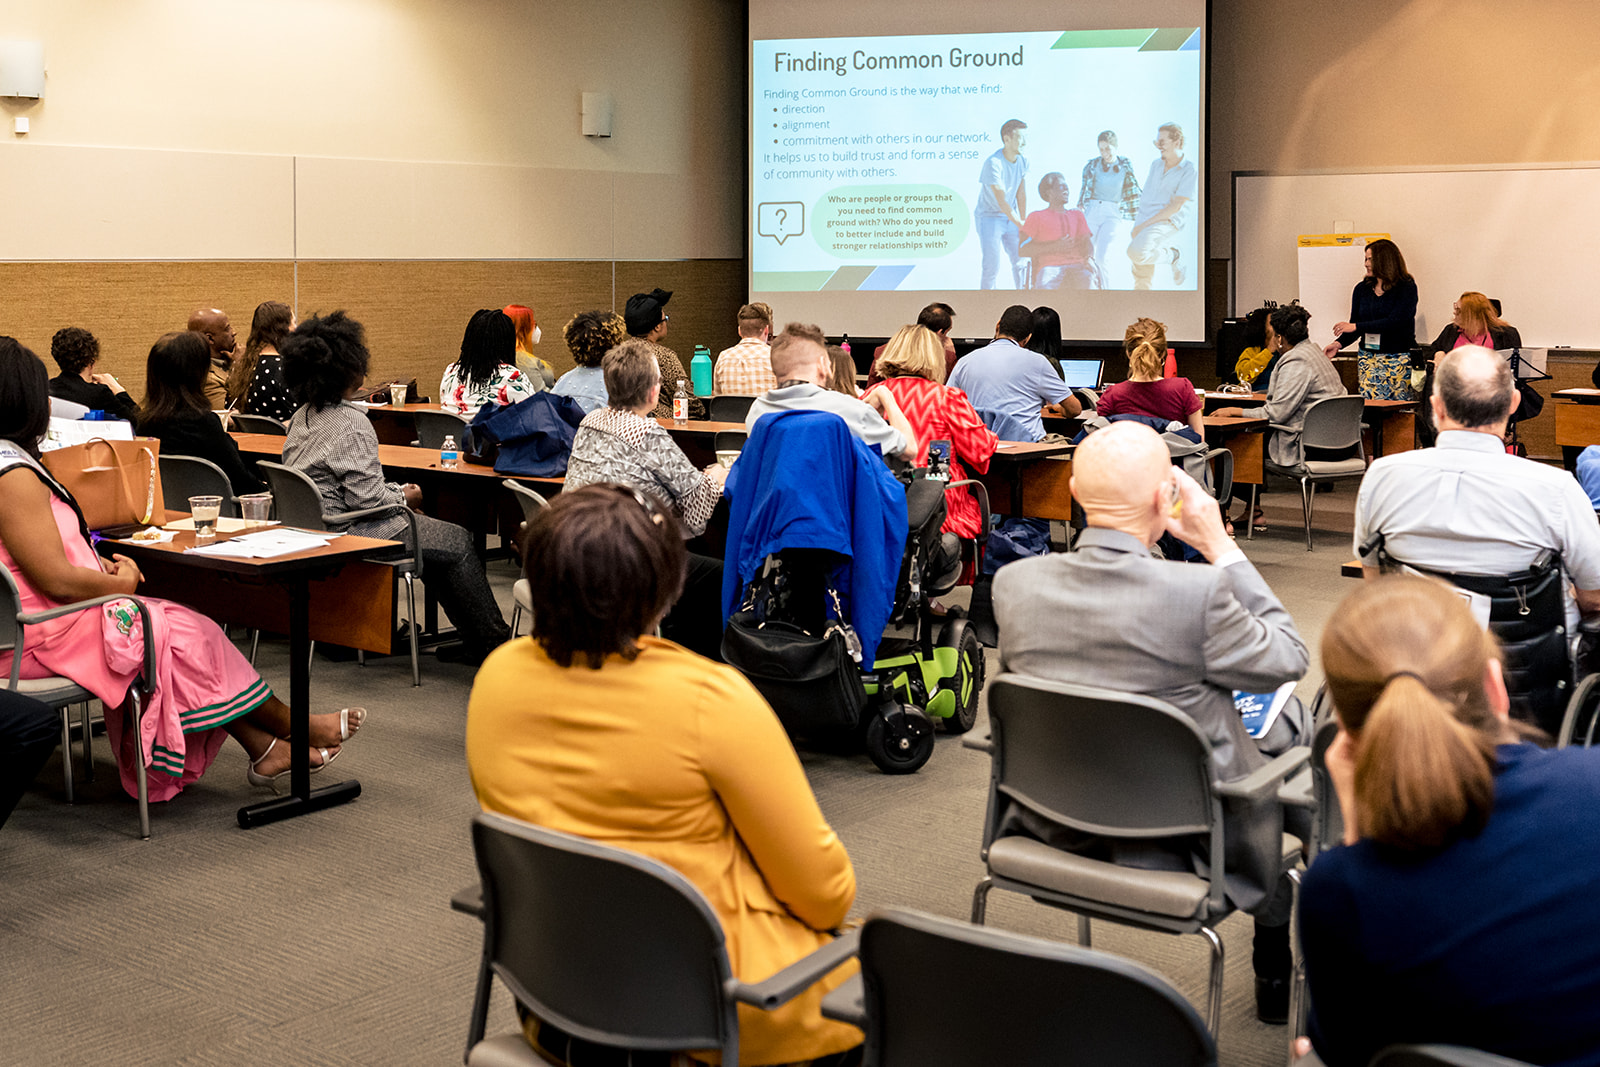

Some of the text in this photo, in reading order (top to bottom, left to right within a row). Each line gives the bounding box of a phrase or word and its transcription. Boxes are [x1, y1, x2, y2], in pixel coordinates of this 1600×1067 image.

[775, 45, 1023, 76] Finding Common Ground
[764, 83, 1003, 101] Finding Common Ground is the way that we find:
[782, 104, 825, 114] direction
[782, 120, 830, 133] alignment
[783, 132, 991, 147] commitment with others in our network.
[764, 149, 979, 165] It helps us to build trust and form a sense
[763, 166, 897, 180] of community with others.
[828, 195, 846, 203] Who
[864, 195, 892, 204] people
[904, 195, 933, 204] groups
[935, 194, 953, 202] that
[838, 208, 853, 216] you
[827, 219, 856, 228] ground
[858, 218, 881, 226] with?
[915, 219, 930, 227] you
[933, 217, 953, 225] need
[846, 230, 872, 238] better
[906, 229, 921, 237] and
[923, 229, 945, 237] build
[832, 240, 948, 251] stronger relationships with?
